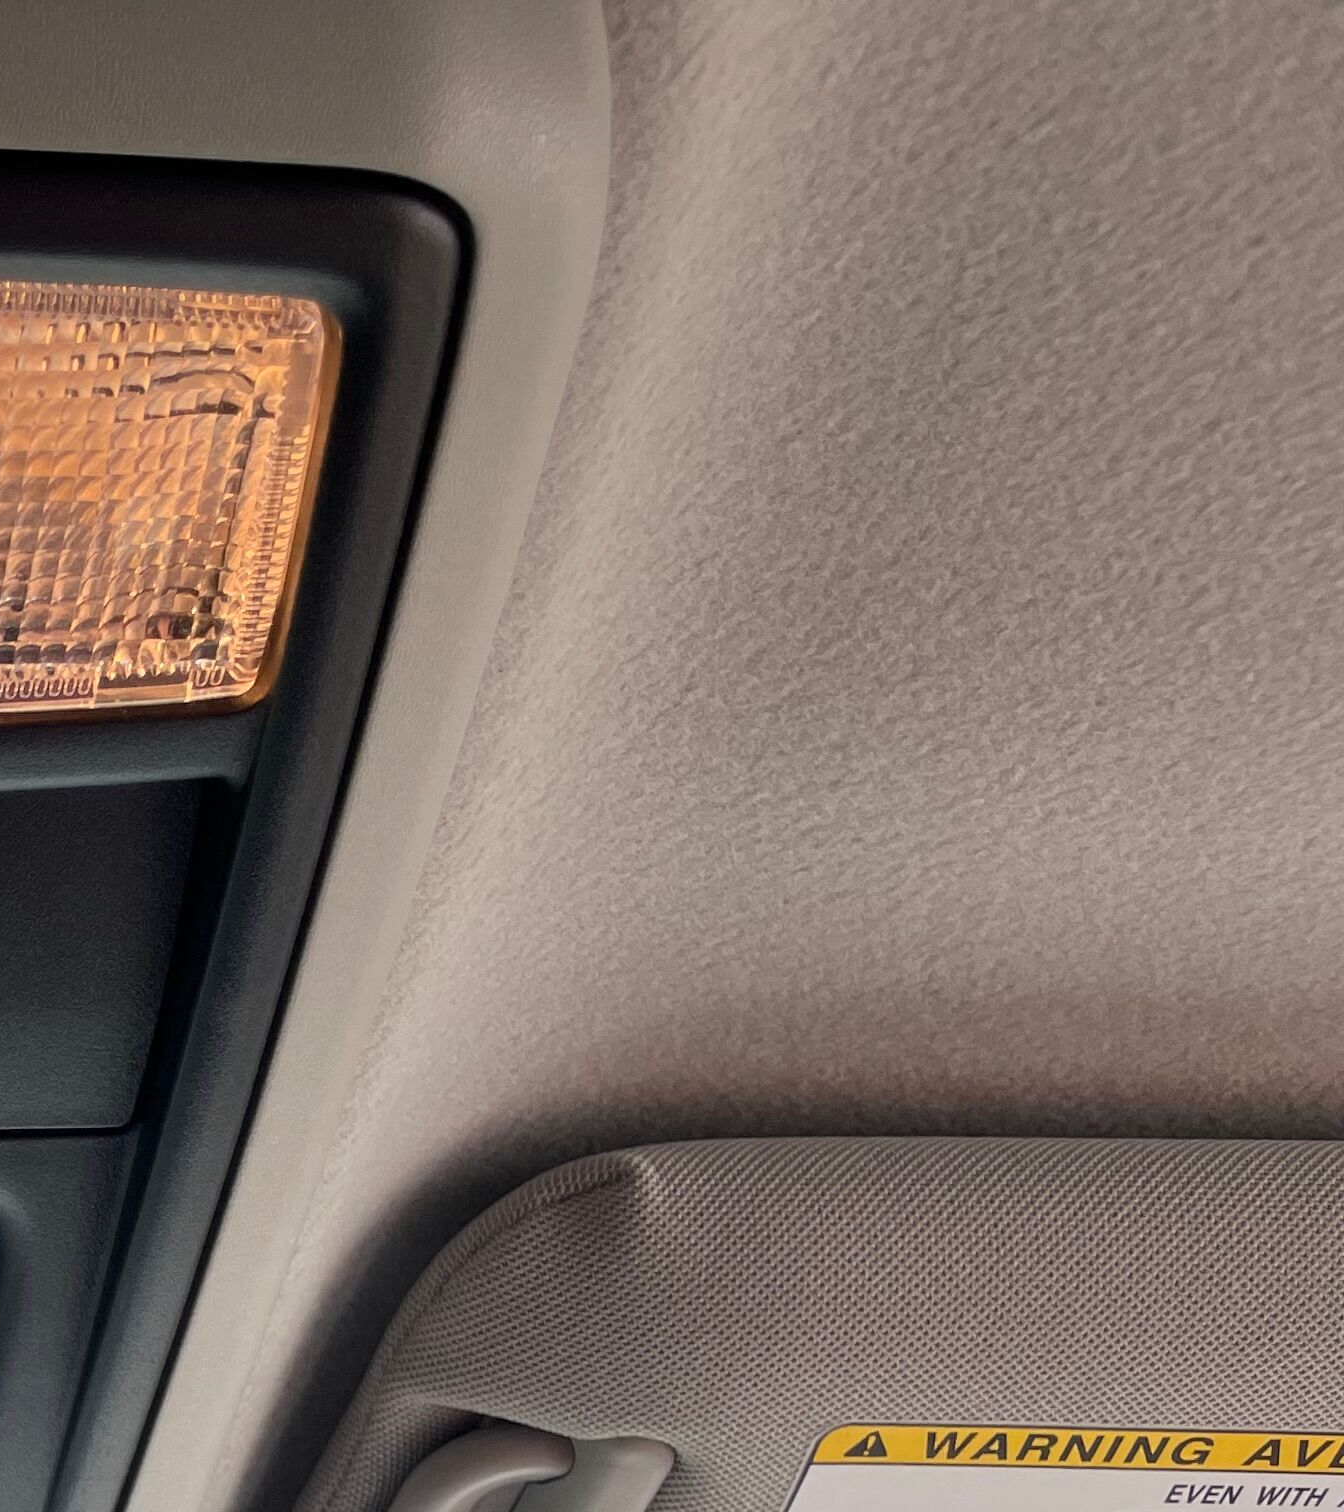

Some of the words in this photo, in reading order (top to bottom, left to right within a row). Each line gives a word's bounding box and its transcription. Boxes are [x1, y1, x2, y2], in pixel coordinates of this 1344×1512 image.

[923, 1430, 1215, 1466] WARNING
[1164, 1484, 1244, 1505] EVEN
[1256, 1486, 1330, 1508] WITH
